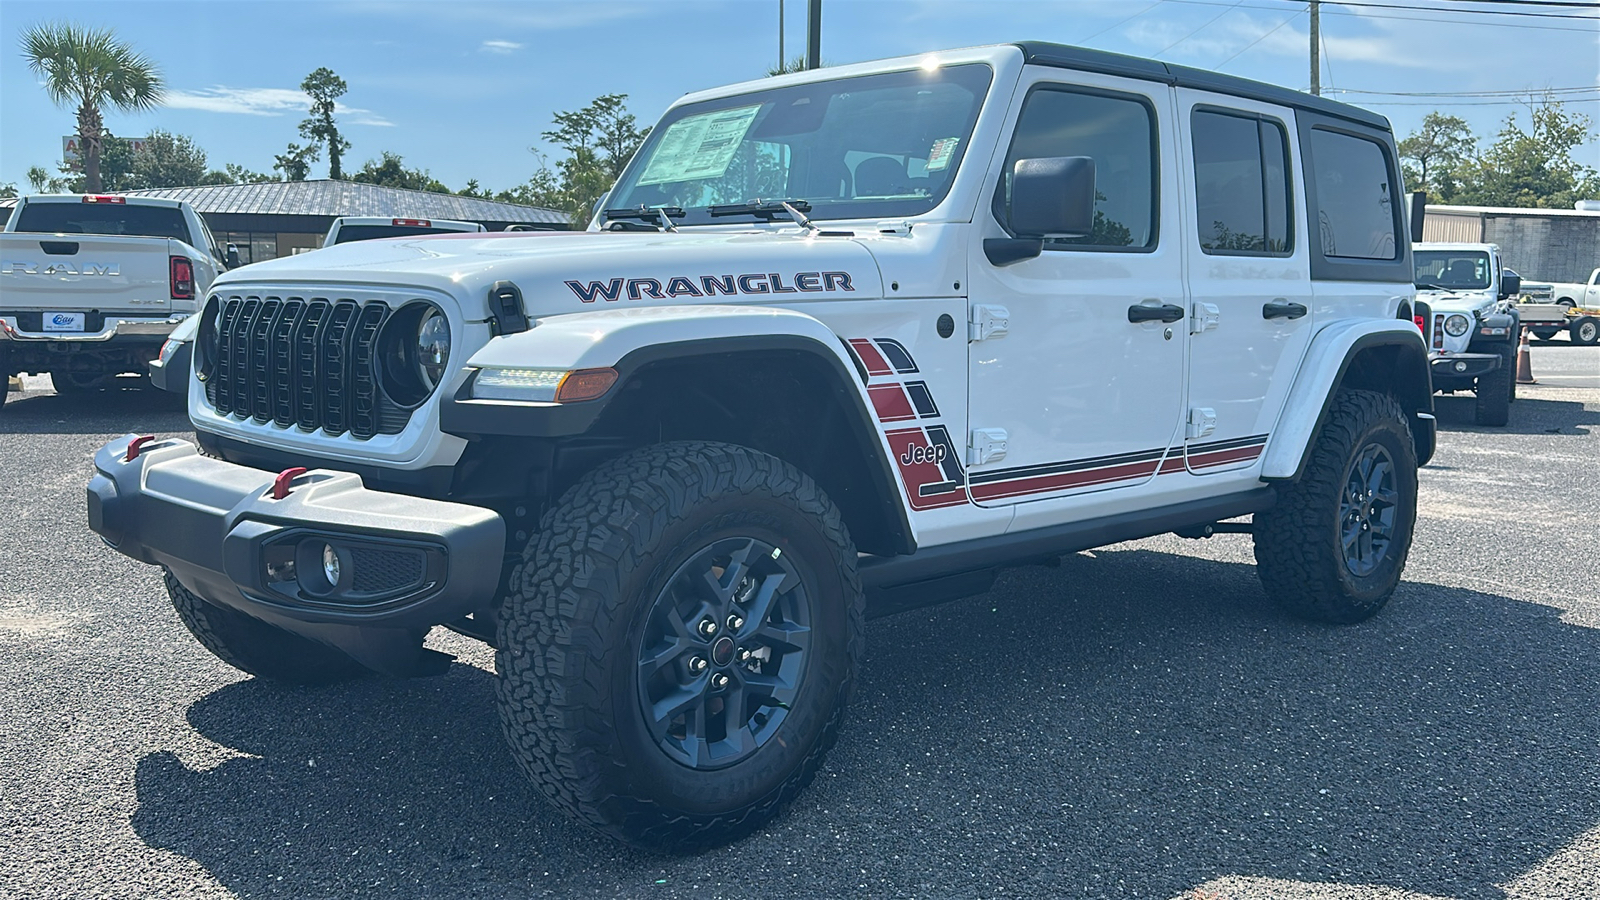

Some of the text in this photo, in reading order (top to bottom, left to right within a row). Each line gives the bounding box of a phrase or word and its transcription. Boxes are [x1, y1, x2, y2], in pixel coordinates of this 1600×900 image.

[1, 260, 120, 276] RAM
[564, 271, 855, 303] WRANGLER
[53, 314, 75, 325] Bay
[901, 443, 946, 466] Jeep
